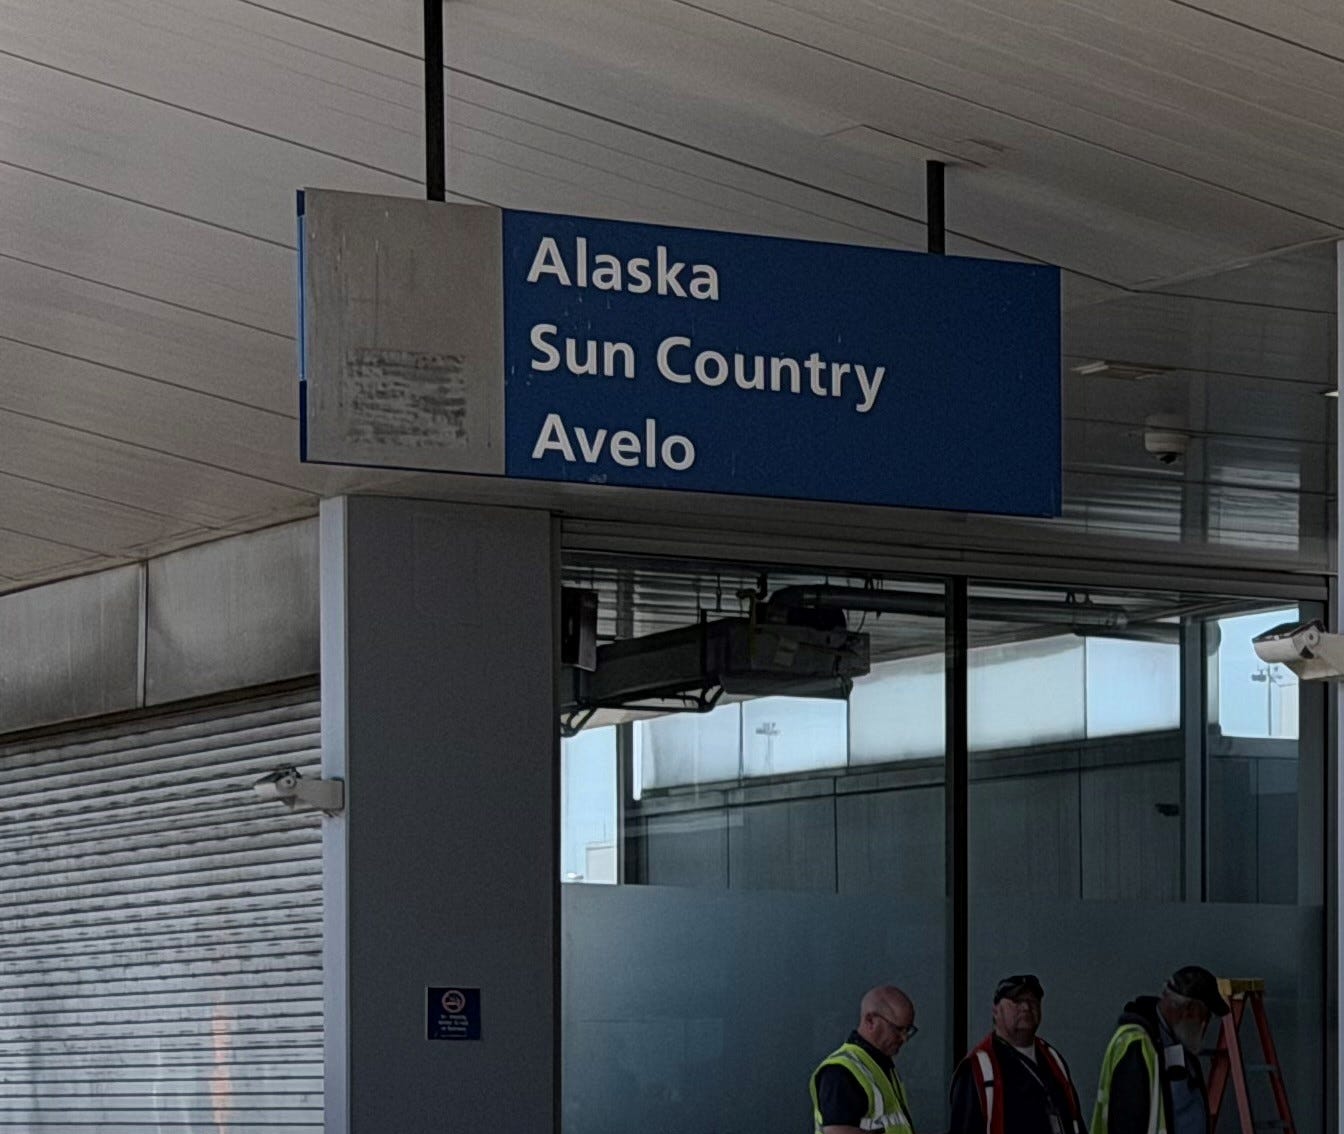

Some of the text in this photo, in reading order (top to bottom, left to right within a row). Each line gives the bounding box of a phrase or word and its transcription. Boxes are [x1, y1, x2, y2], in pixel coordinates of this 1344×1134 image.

[527, 236, 719, 301] Alaska
[530, 323, 886, 413] Sun Country
[532, 413, 695, 472] Avelo
